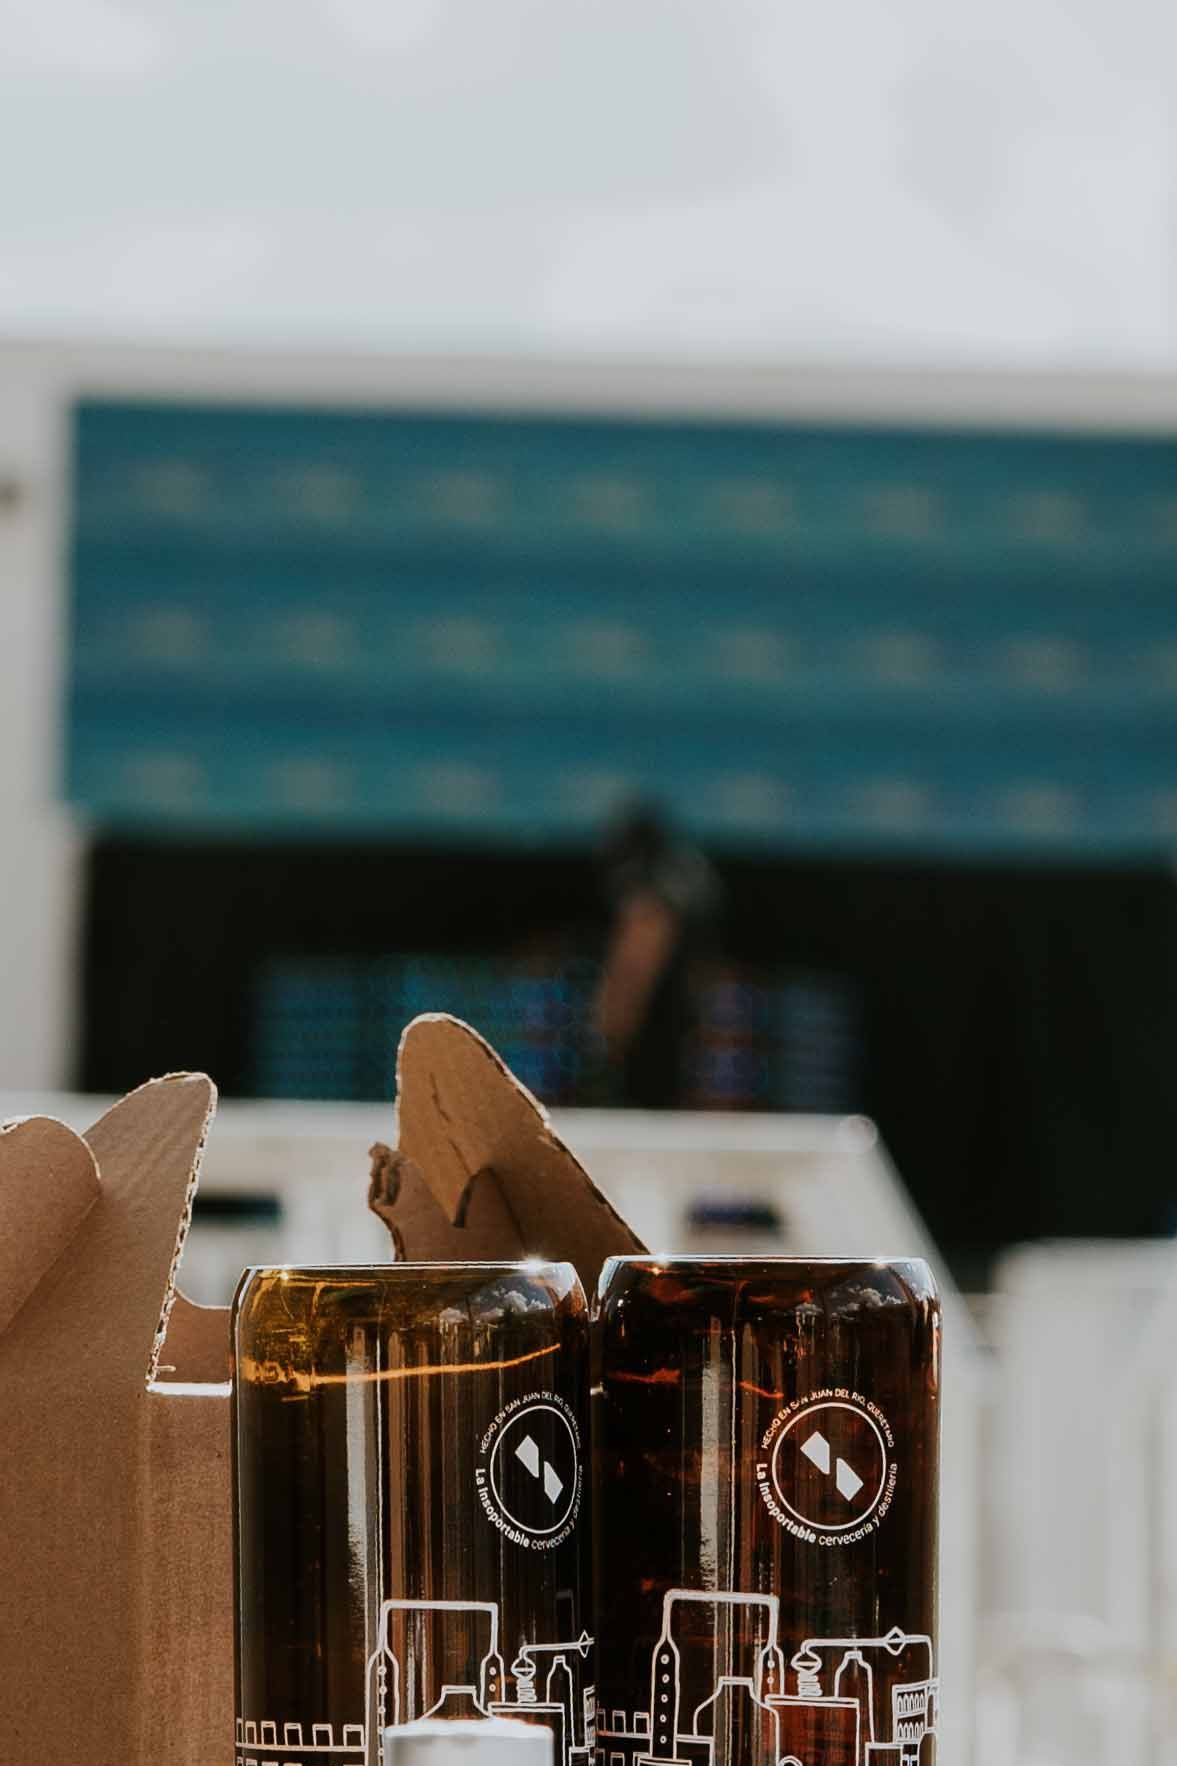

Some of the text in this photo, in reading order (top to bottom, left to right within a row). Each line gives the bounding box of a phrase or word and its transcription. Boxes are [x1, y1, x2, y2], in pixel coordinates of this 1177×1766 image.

[480, 1422, 497, 1454] HECHO
[522, 1391, 541, 1405] JUAN
[761, 1417, 780, 1450] HECHO
[778, 1406, 792, 1421] EN
[790, 1395, 809, 1411] SAN
[810, 1388, 834, 1402] JUAN
[834, 1387, 850, 1399] DEL
[474, 1467, 486, 1486] La
[756, 1462, 768, 1481] La
[478, 1486, 530, 1550] Insoportable
[758, 1481, 817, 1544] Insoportable
[872, 1515, 881, 1529] y
